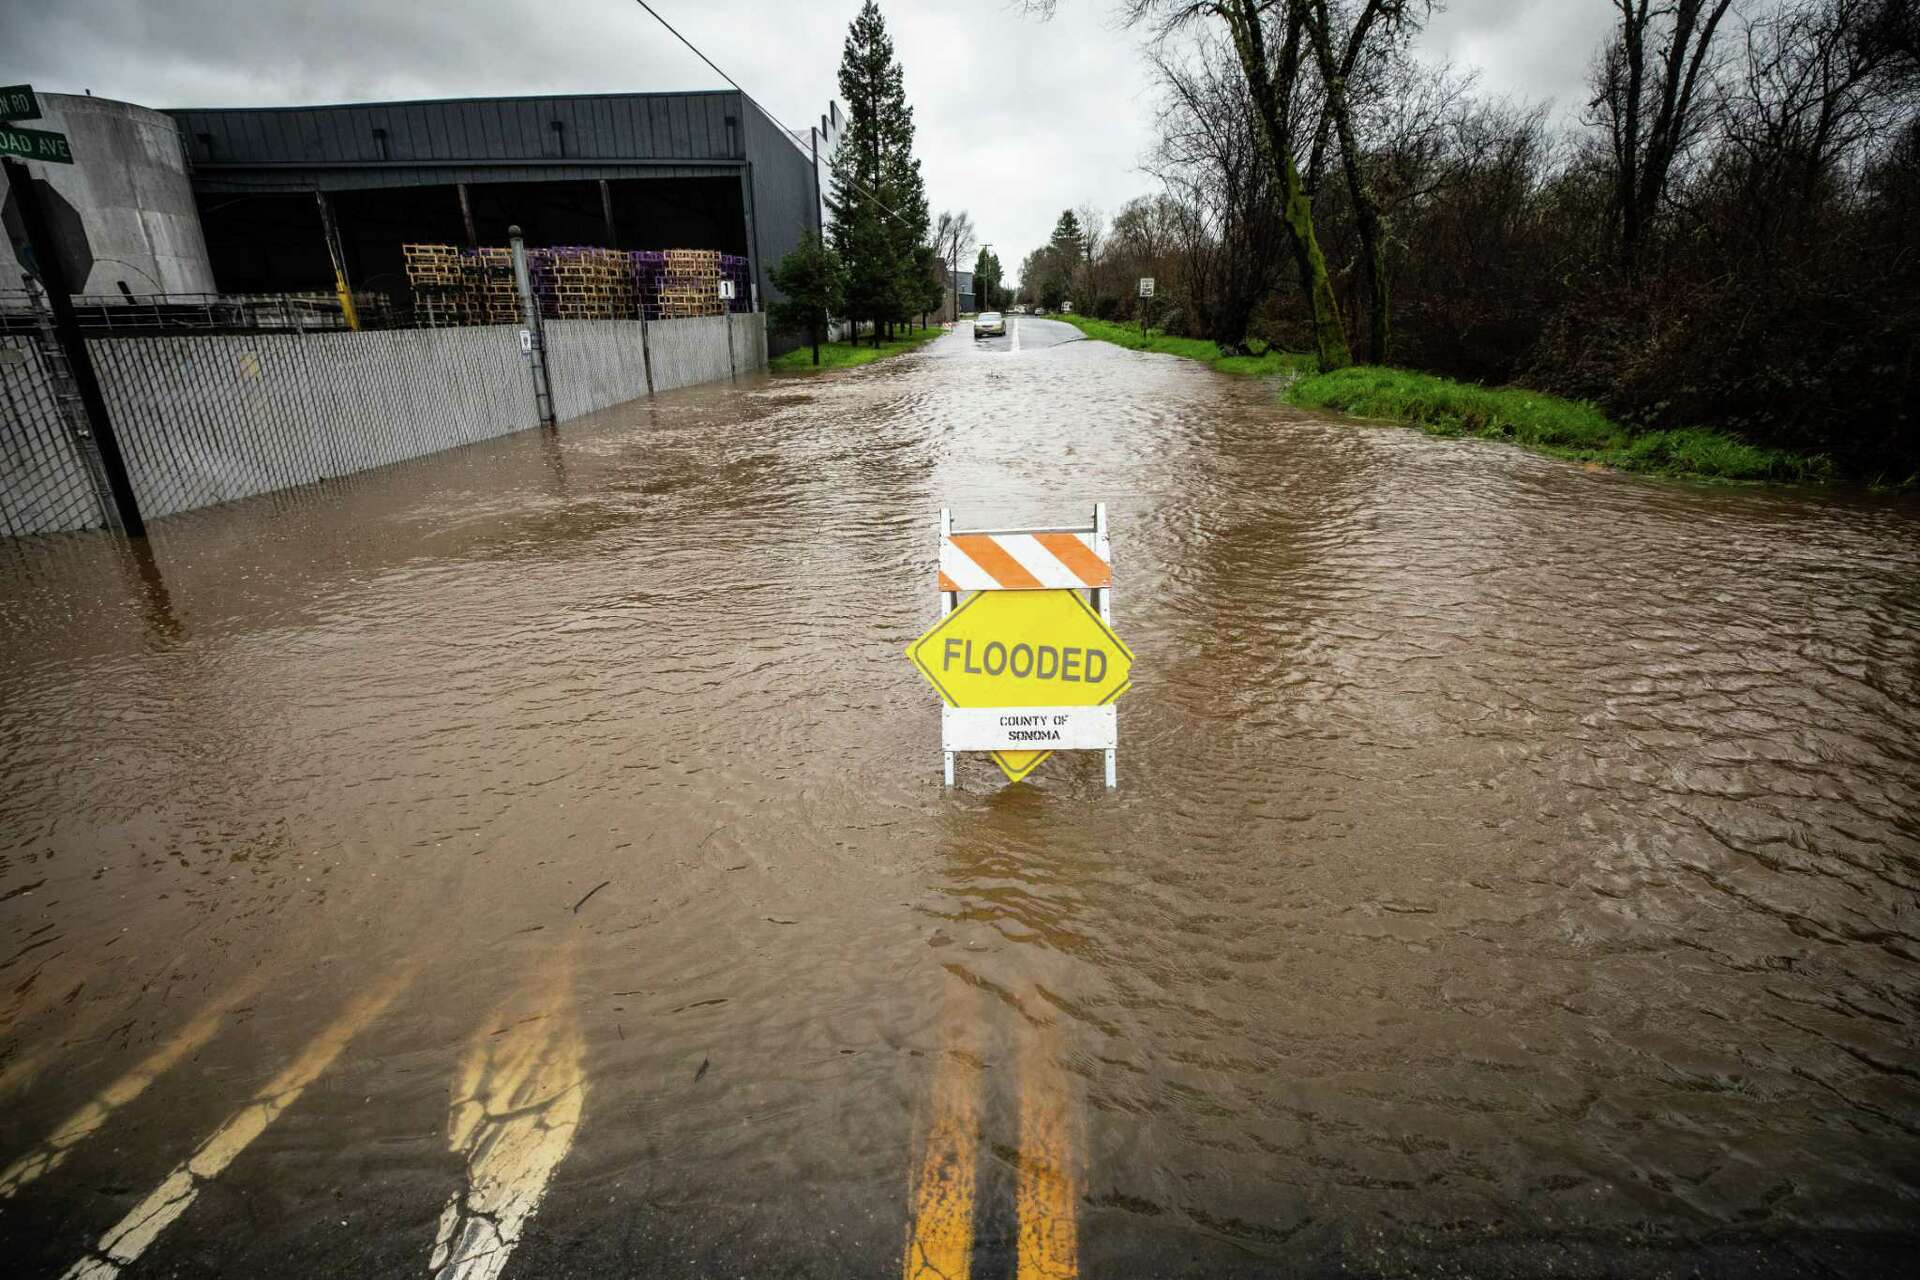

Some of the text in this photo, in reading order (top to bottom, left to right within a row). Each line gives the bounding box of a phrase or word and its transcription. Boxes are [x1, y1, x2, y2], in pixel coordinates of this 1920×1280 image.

[11, 94, 30, 112] RD
[39, 137, 69, 157] AVE
[943, 638, 1108, 683] FLOODED
[1000, 714, 1069, 727] COUNTY OF
[1008, 729, 1061, 741] SONOMA
